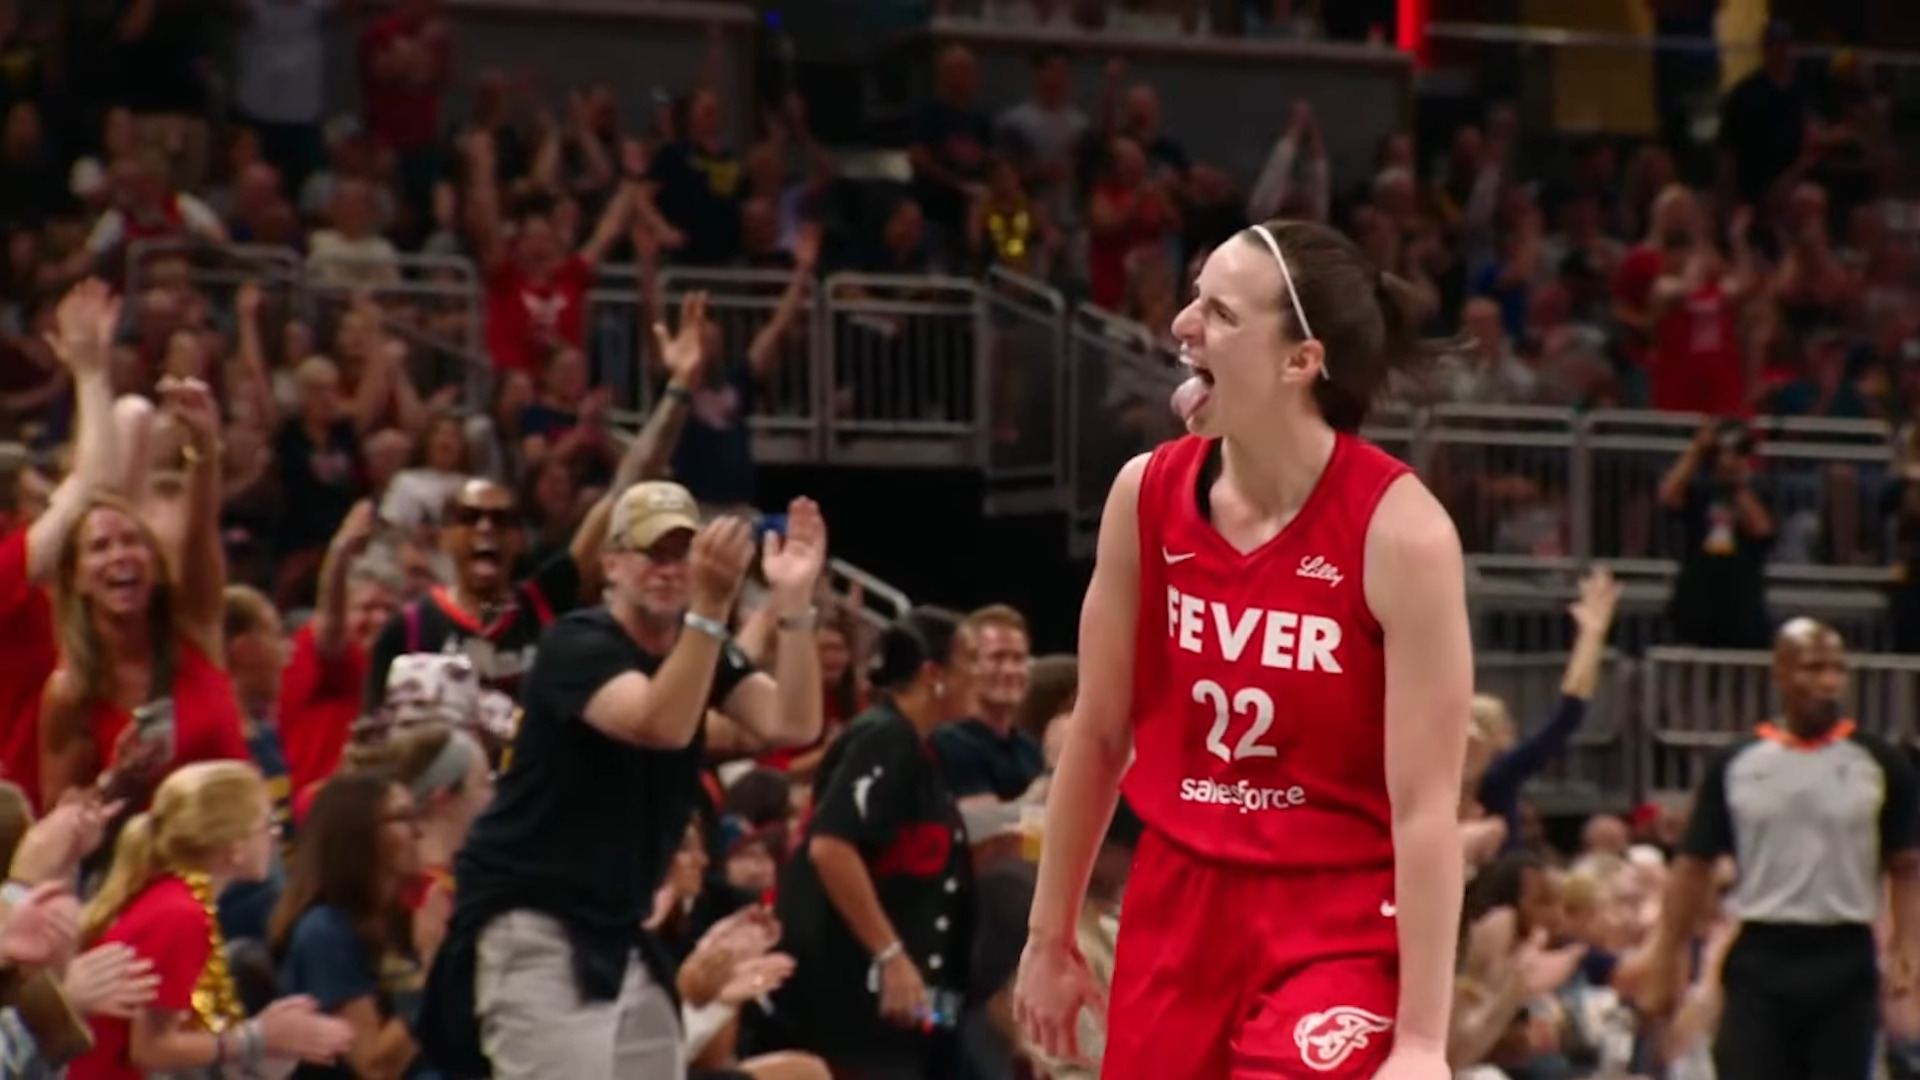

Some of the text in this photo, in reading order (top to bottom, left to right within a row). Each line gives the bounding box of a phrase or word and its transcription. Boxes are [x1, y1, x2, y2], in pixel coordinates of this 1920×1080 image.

[1296, 555, 1344, 588] Lilly
[1167, 584, 1343, 673] FEVER
[1192, 679, 1278, 763] 22
[1180, 777, 1306, 813] salesforce
